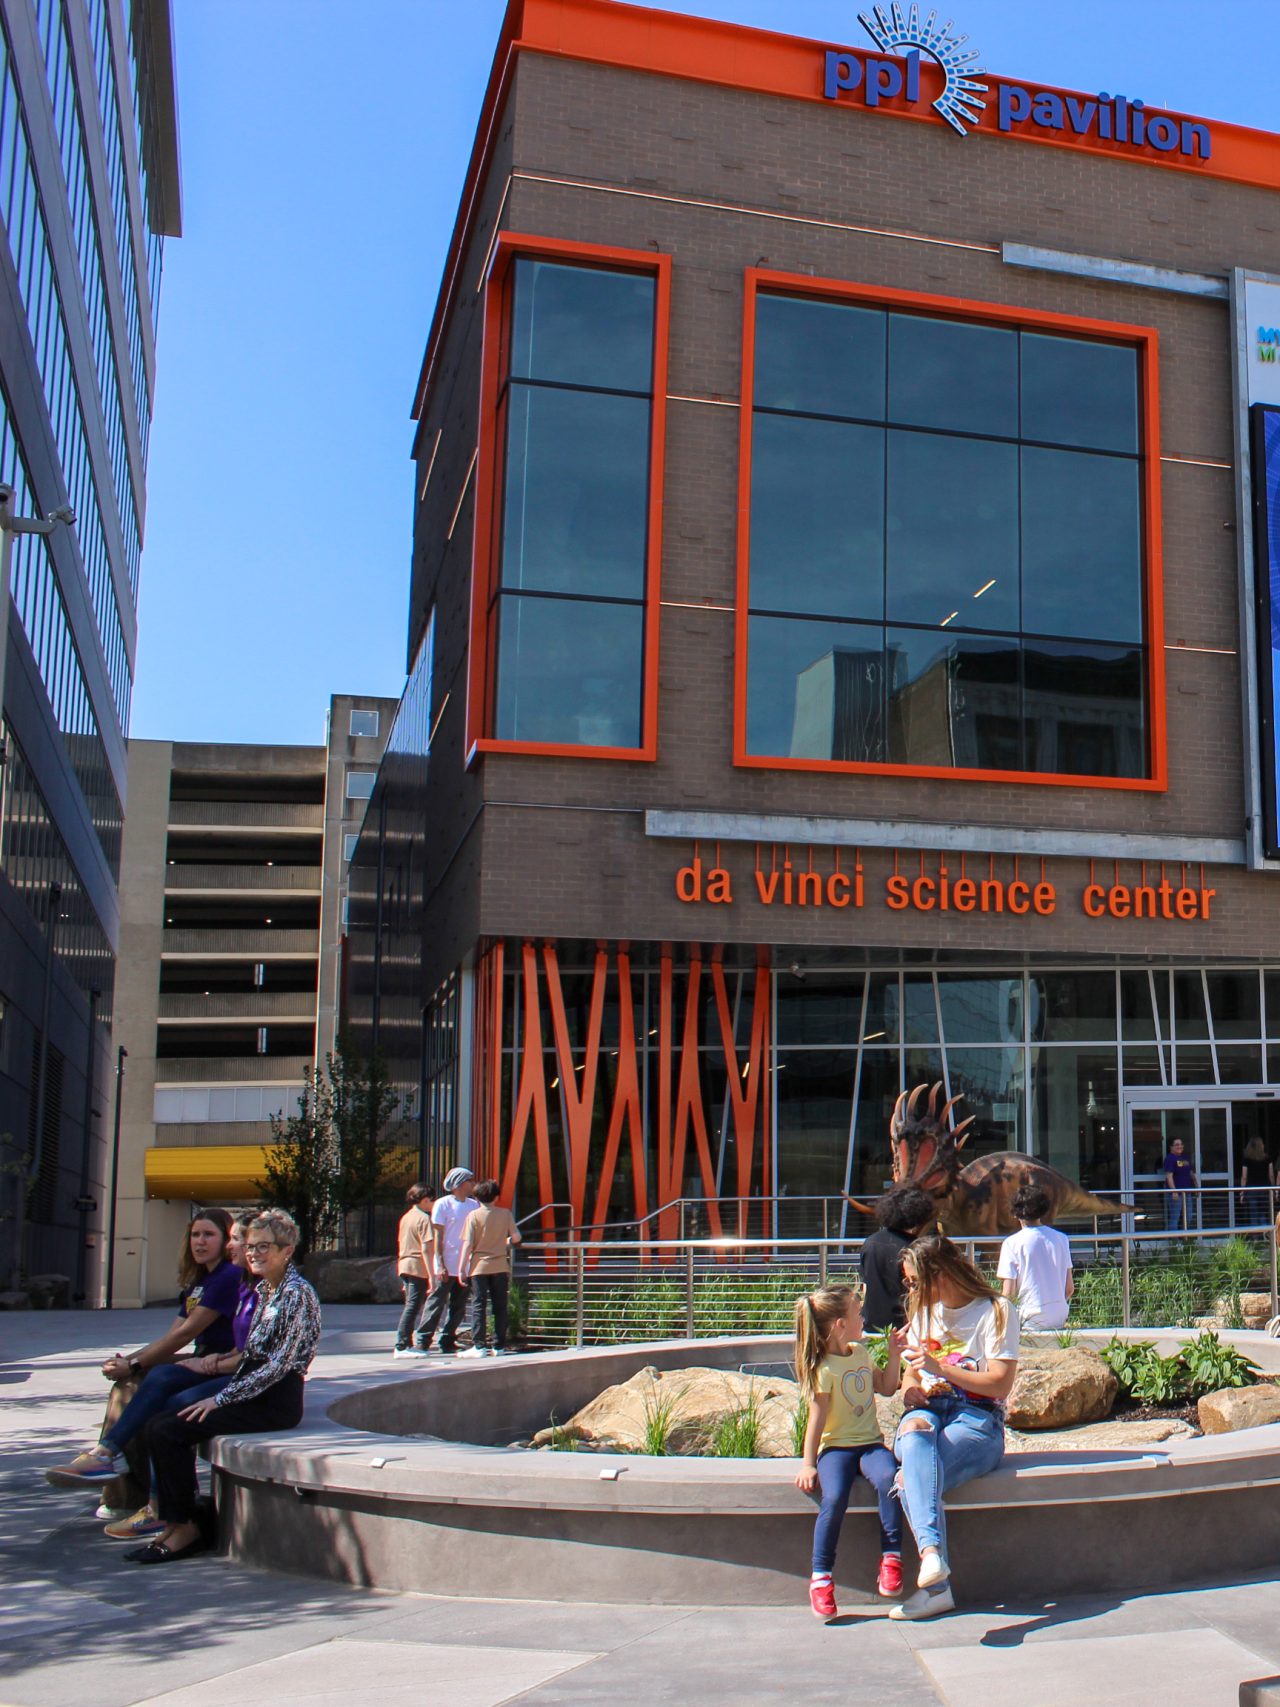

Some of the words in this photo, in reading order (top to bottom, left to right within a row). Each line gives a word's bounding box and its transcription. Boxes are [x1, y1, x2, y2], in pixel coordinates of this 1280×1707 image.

[824, 49, 920, 106] ppl
[998, 84, 1212, 159] pavilion
[1259, 346, 1275, 363] MI
[675, 858, 732, 903] da
[755, 861, 865, 908] vinci
[886, 867, 1057, 915] science
[1083, 876, 1216, 921] center
